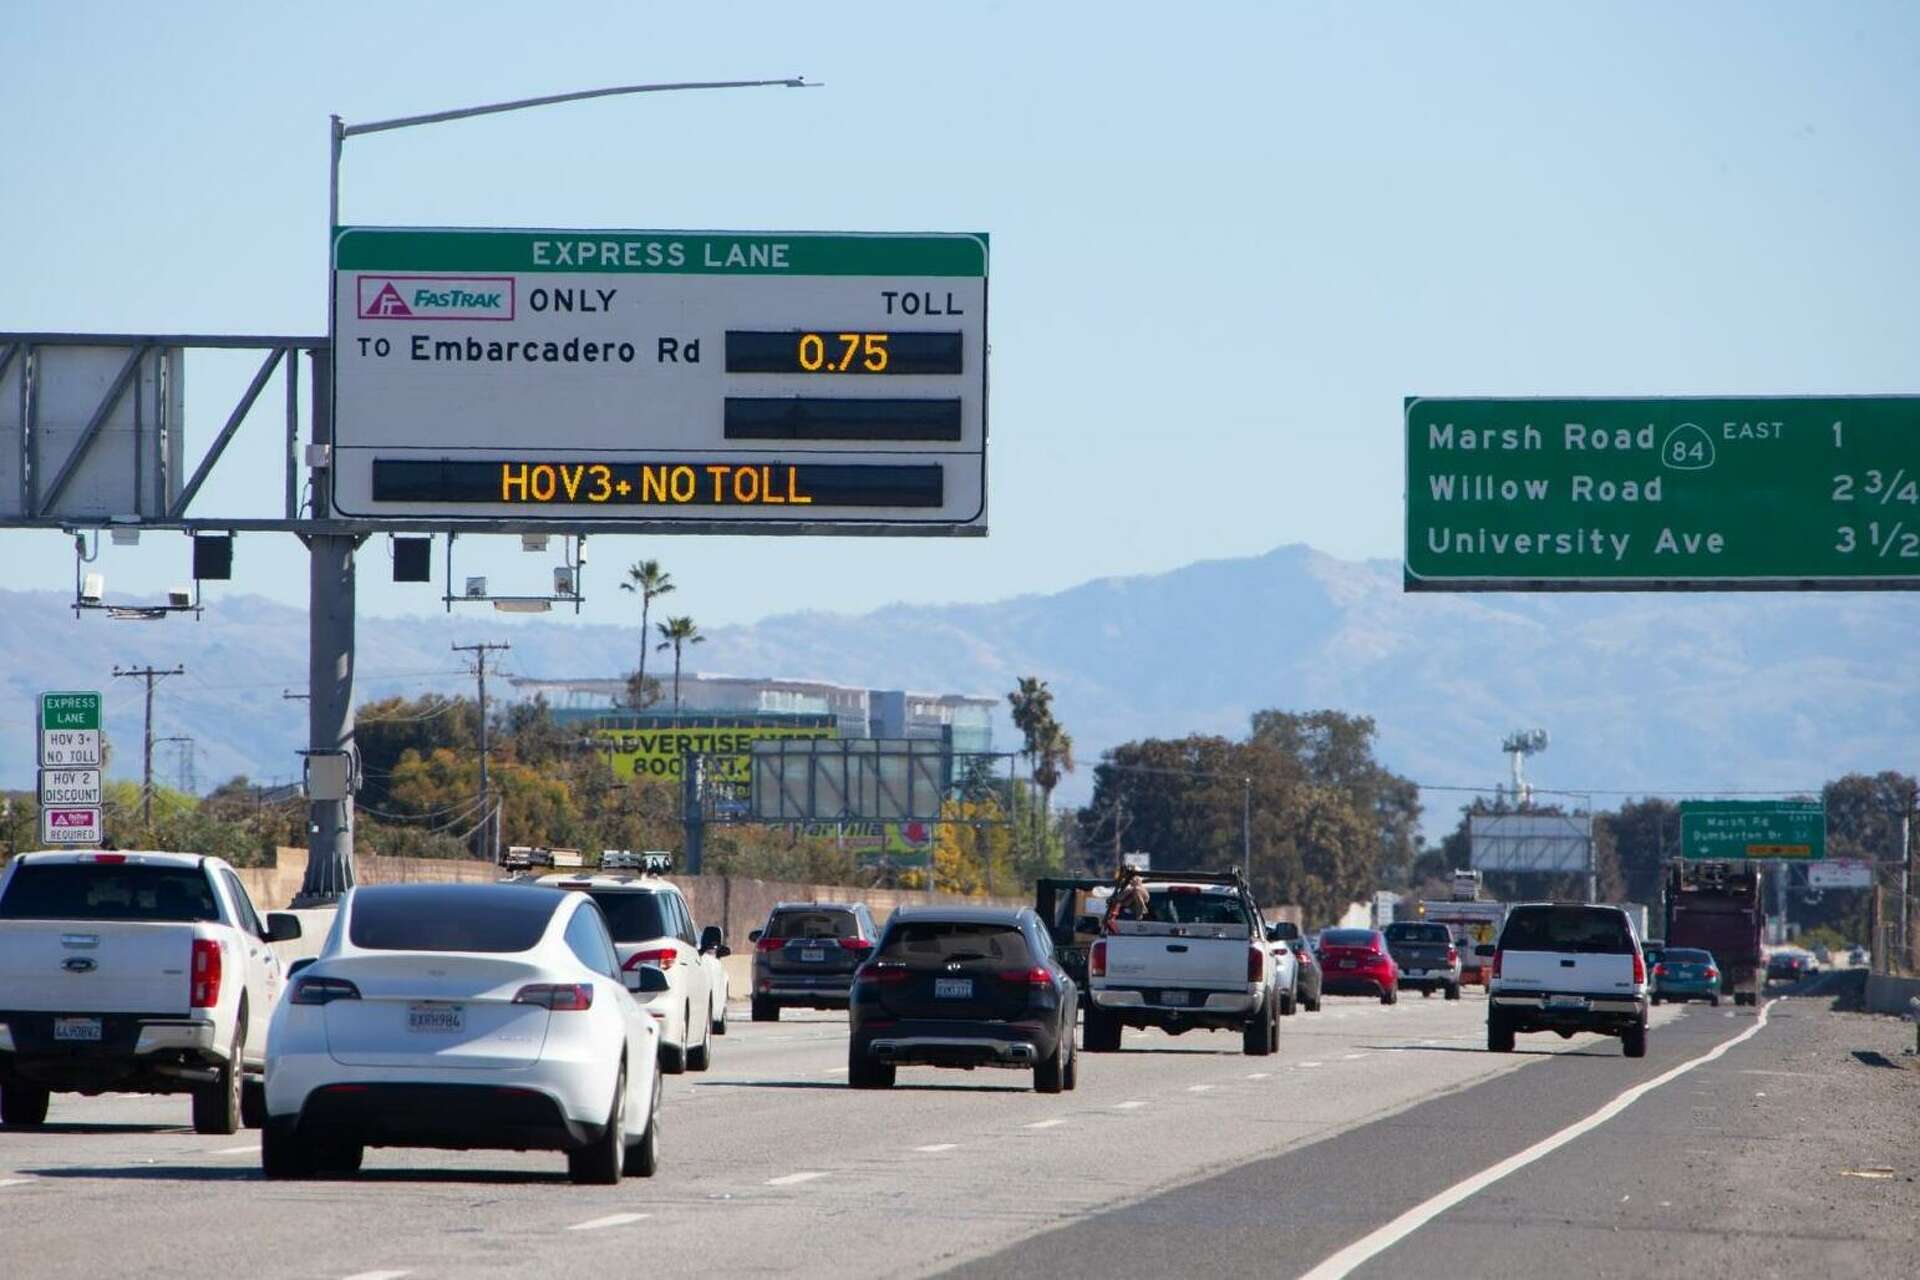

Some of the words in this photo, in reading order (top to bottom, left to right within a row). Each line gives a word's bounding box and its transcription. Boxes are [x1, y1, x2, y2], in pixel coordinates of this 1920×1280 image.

[533, 241, 685, 267] EXPRESS
[704, 242, 790, 268] LANE
[529, 288, 617, 313] ONLY
[881, 291, 964, 316] TOLL
[356, 337, 391, 358] TO
[411, 335, 635, 363] Embarcadero
[658, 337, 700, 364] Rd
[799, 333, 889, 372] 0.75
[1428, 423, 1543, 450] Marsh
[1564, 423, 1655, 450] Road
[1671, 440, 1704, 462] 84
[1723, 422, 1784, 440] EAST
[1832, 421, 1843, 448] 1
[501, 464, 632, 503] HOV3+
[642, 465, 696, 503] NO
[706, 465, 812, 504] TOLL
[1429, 474, 1549, 501] Willow
[1572, 475, 1662, 502] Road
[1428, 527, 1631, 561] University
[1654, 527, 1725, 554] Ave
[46, 697, 97, 709] EXPRESS
[56, 712, 86, 724] LANE
[50, 733, 74, 746] HOV
[602, 734, 750, 754] ADVERTISE
[47, 750, 63, 763] NO
[70, 750, 96, 763] TOLL
[53, 772, 76, 785] HOV
[82, 772, 90, 785] 2
[45, 789, 98, 801] DISCOUNT
[50, 829, 95, 840] REQUIRED
